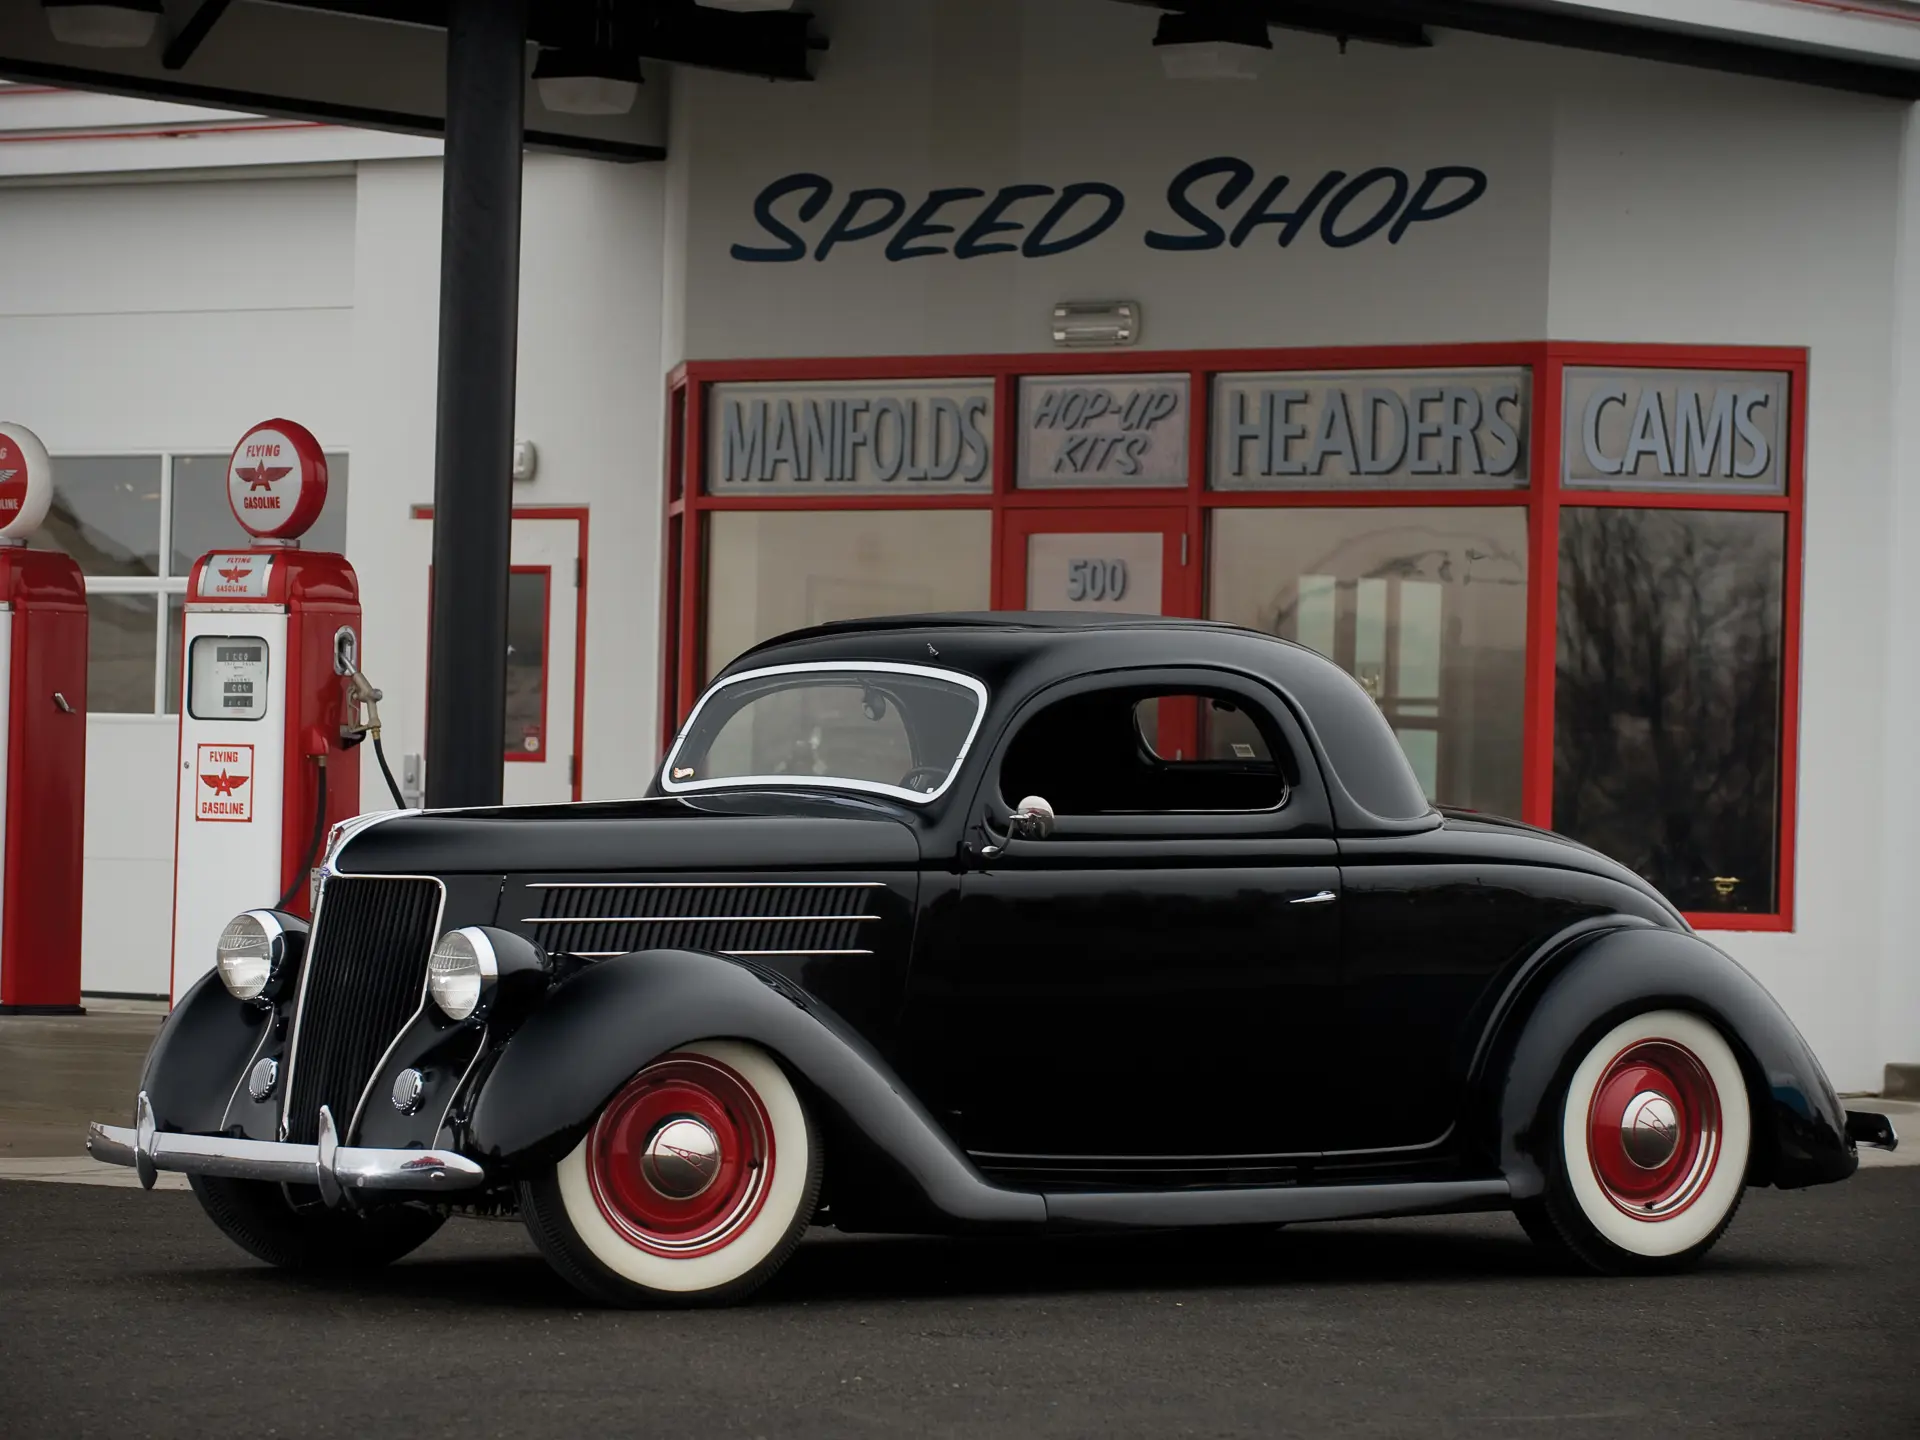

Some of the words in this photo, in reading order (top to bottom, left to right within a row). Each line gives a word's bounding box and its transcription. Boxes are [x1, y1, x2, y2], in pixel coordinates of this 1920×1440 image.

[730, 173, 1125, 262] SPEED
[1144, 156, 1487, 251] SHOP
[1032, 386, 1180, 432] HOP-UP
[1228, 385, 1524, 476] HEADERS
[246, 444, 281, 458] FLYING
[722, 396, 993, 483] MANIFOLDS
[1052, 431, 1152, 475] KITS
[1581, 386, 1772, 478] CAMS
[243, 496, 281, 509] GASOLINE
[216, 585, 248, 593] GASOLINE
[1067, 558, 1127, 602] 500
[209, 751, 239, 763] FLYING
[202, 802, 244, 815] GASOLINE
